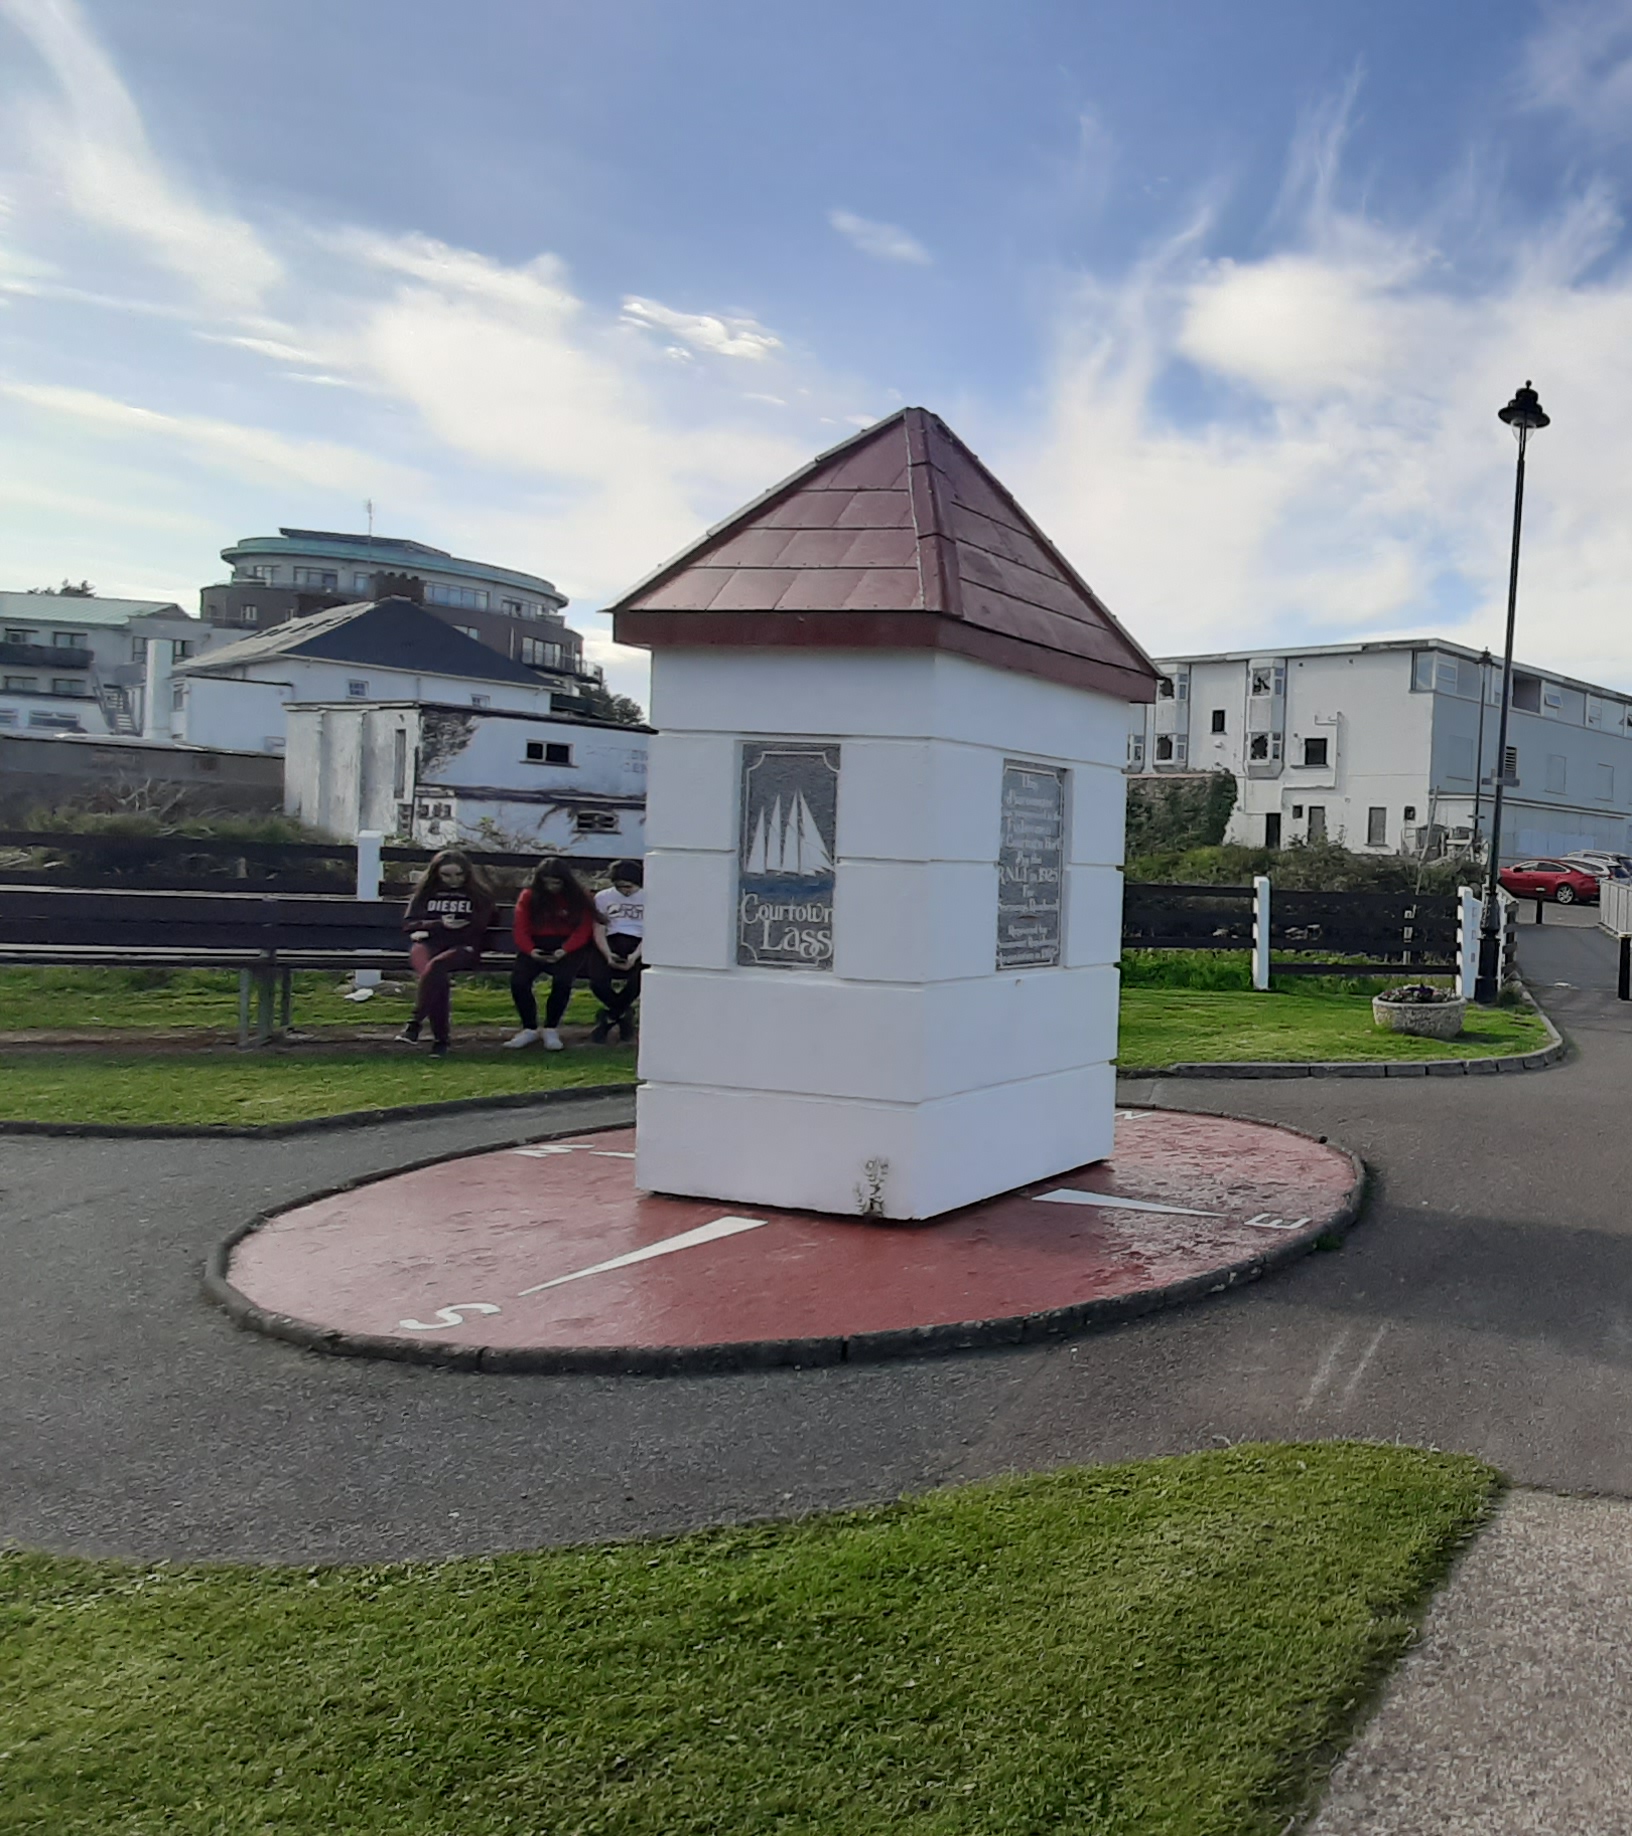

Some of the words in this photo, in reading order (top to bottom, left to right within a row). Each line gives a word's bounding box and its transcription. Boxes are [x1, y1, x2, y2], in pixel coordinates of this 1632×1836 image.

[999, 866, 1027, 885] RNLI
[427, 899, 473, 913] DIESEL
[759, 919, 833, 960] Lass
[1243, 1213, 1312, 1230] E
[399, 1302, 501, 1330] S
